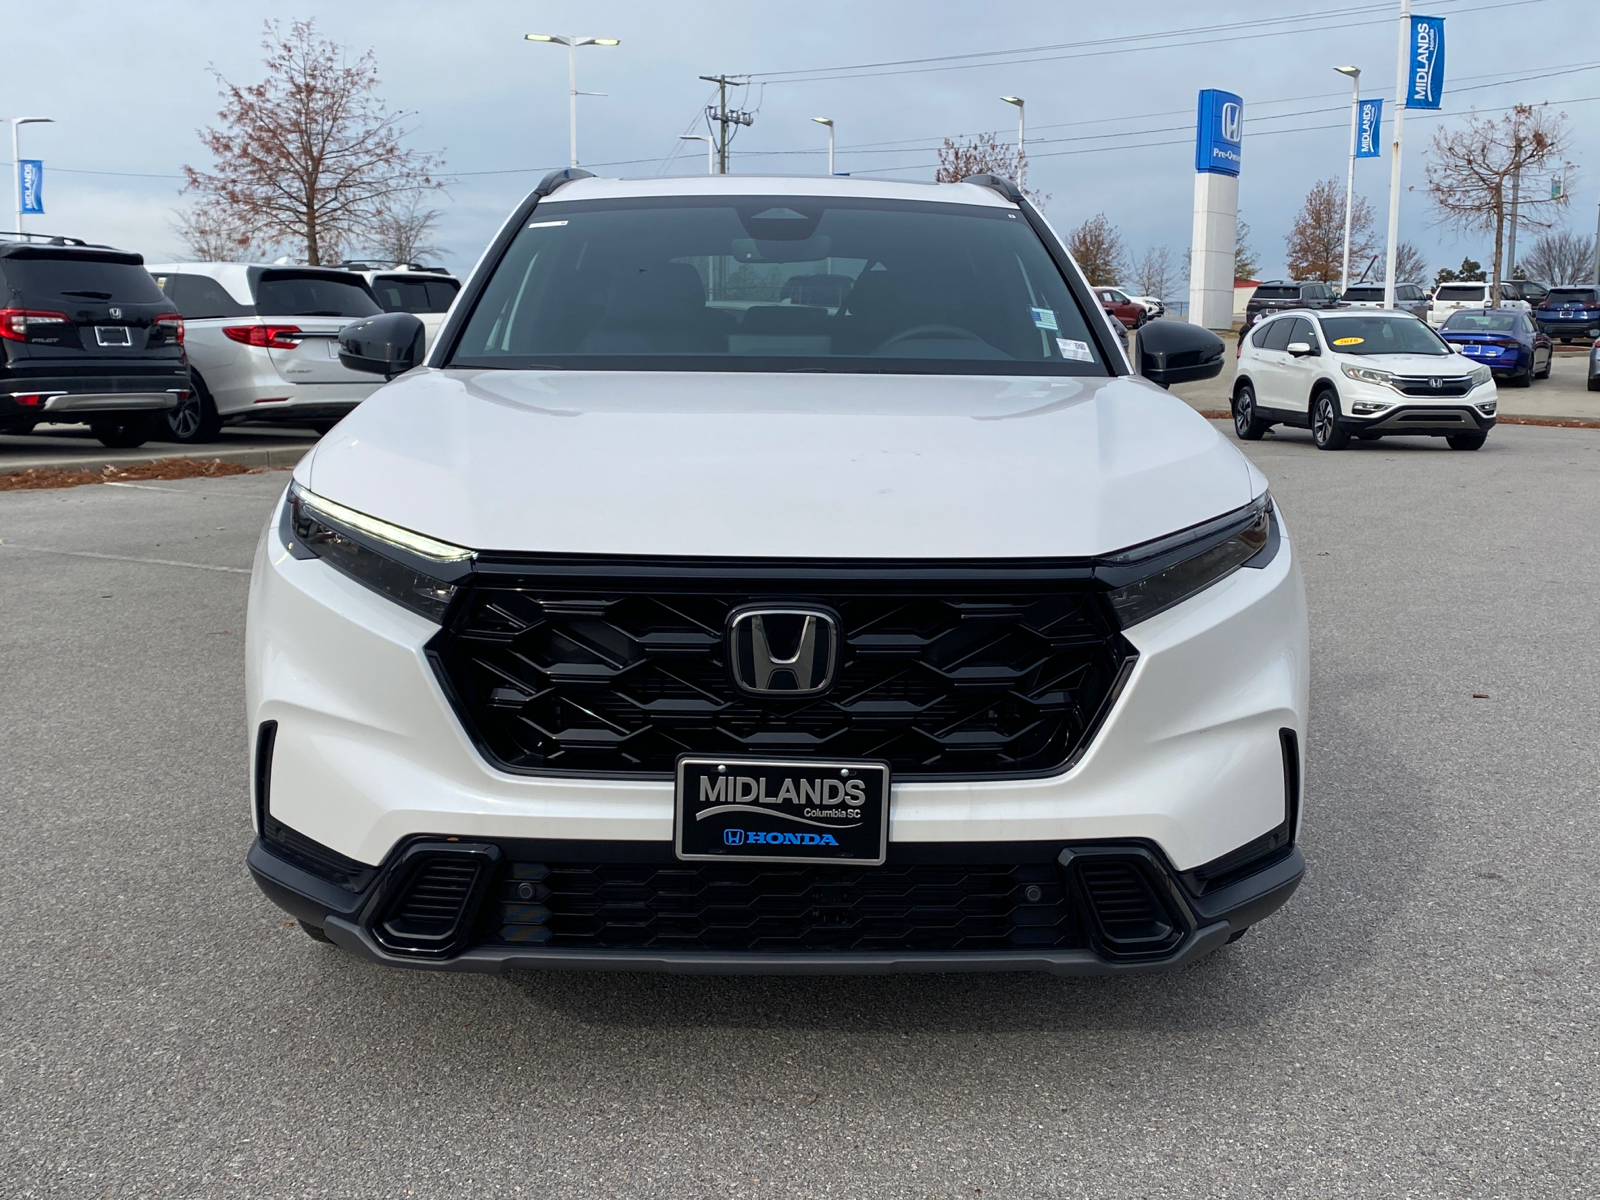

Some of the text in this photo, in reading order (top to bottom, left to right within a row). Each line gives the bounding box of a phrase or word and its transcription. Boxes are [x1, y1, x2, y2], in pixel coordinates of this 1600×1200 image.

[1414, 23, 1429, 99] MIDLANDS
[1361, 104, 1371, 152] MIDLANDS
[24, 163, 32, 209] MIDLANDS
[699, 775, 866, 807] MIDLANDS
[803, 808, 861, 818] Columbia SC
[746, 831, 839, 846] HONDA
